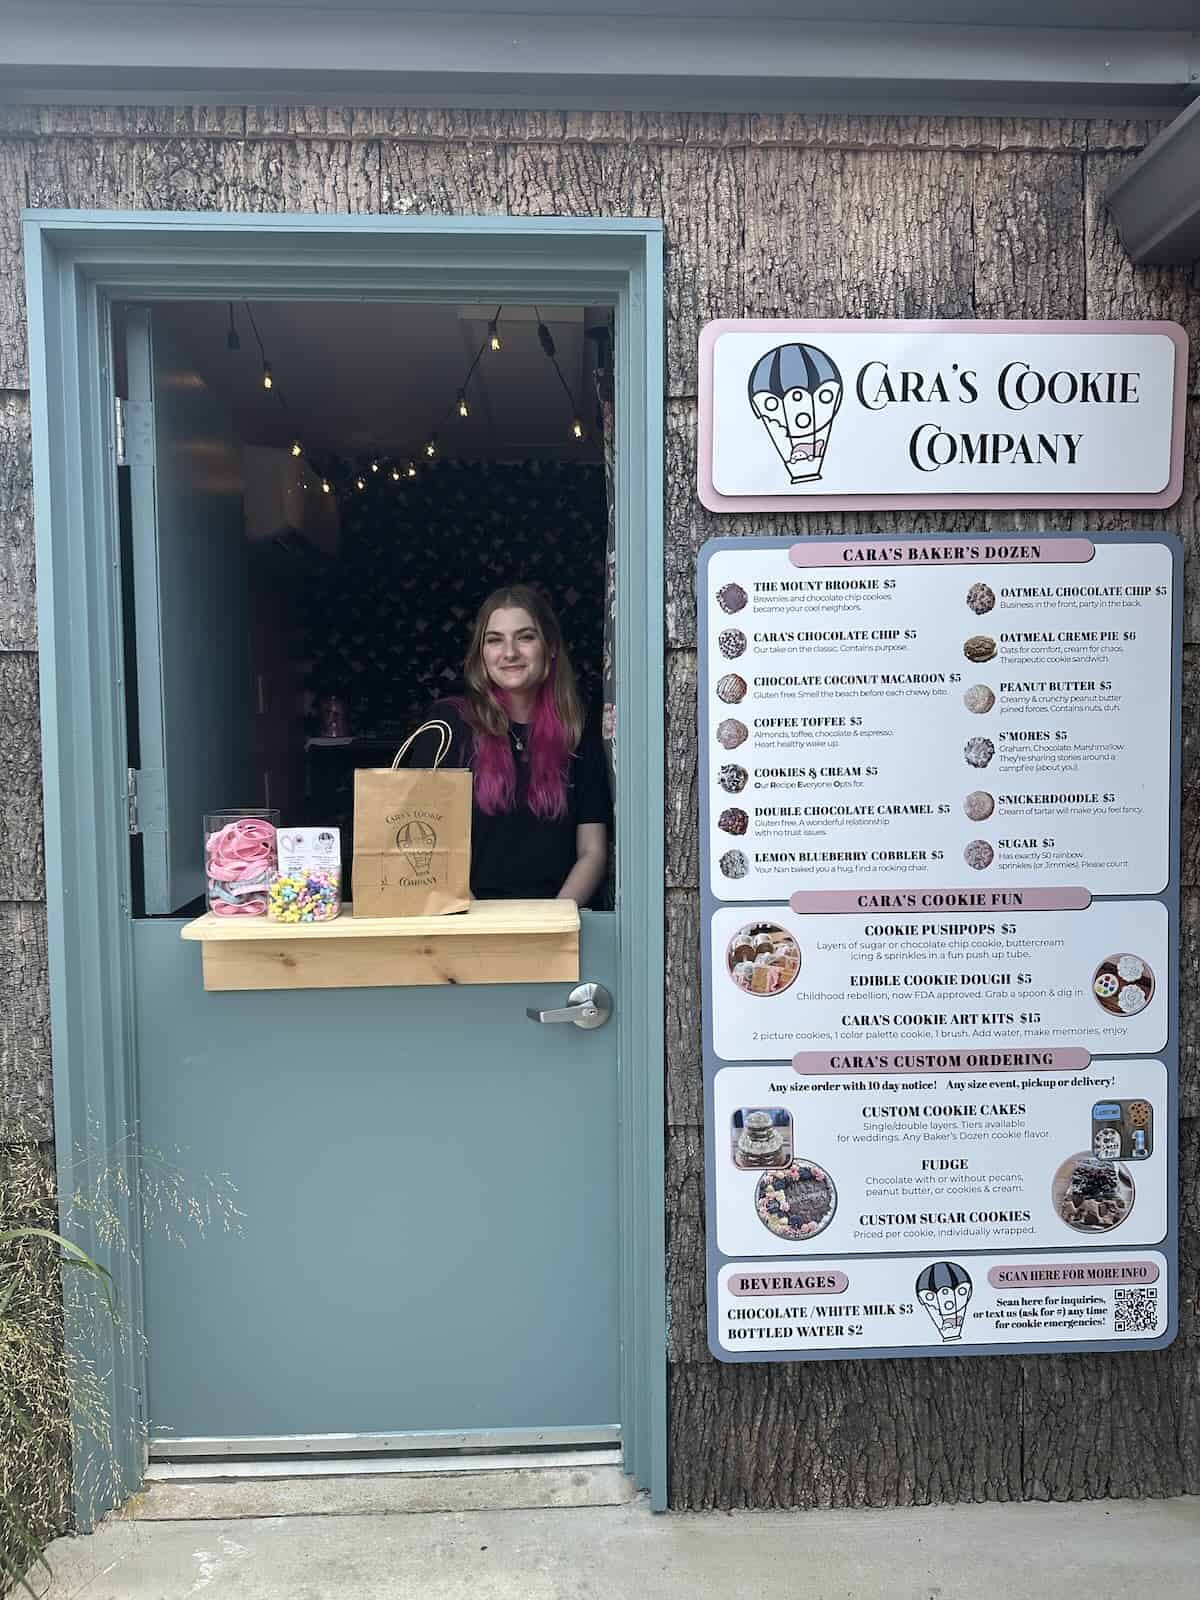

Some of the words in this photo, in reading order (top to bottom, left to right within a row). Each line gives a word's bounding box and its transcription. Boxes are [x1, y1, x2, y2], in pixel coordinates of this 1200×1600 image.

[997, 361, 1141, 410] COOKIE
[909, 423, 1084, 472] COMPANY
[842, 548, 903, 562] CARA'S
[908, 547, 980, 561] BAKER'S
[984, 546, 1041, 558] DOZEN
[753, 582, 778, 591] THE
[780, 581, 823, 591] MOUNT
[825, 580, 880, 590] BROOKIE
[883, 580, 896, 589] $5
[1000, 588, 1054, 597] OATMEAL
[1055, 587, 1123, 597] CHOCOLATE
[1124, 586, 1152, 596] CHIP
[1155, 586, 1167, 595] $5
[785, 606, 803, 614] your
[753, 632, 795, 642] CARA'S
[796, 631, 869, 641] CHOCOLATE
[871, 630, 900, 639] CHIP
[903, 630, 917, 639] $5
[1000, 632, 1056, 642] OATMEAL
[1057, 632, 1098, 641] CREME
[1100, 632, 1119, 640] PIE
[753, 676, 822, 686] CHOCOLATE
[823, 675, 879, 685] COCONUT
[880, 674, 945, 684] MACAROON
[999, 682, 1048, 692] PEANUT
[1049, 682, 1096, 691] BUTTER
[1099, 681, 1112, 690] $5
[753, 718, 799, 727] COFFEE
[800, 717, 846, 727] TOFFEE
[849, 717, 863, 726] $5
[998, 731, 1050, 741] S'MORES
[1055, 731, 1068, 740] $5
[754, 768, 806, 777] COOKIES
[808, 768, 817, 779] &
[820, 767, 861, 776] CREAM
[998, 794, 1099, 804] SNICKERDOODLE
[755, 807, 802, 816] DOUBLE
[803, 806, 875, 815] CHOCOLATE
[877, 805, 934, 814] CARAMEL
[998, 839, 1038, 848] SUGAR
[1042, 839, 1055, 848] $5
[755, 853, 796, 862] LEMON
[798, 852, 868, 861] BLUEBERRY
[871, 851, 927, 860] COBBLER
[857, 895, 919, 907] CARA'S
[919, 894, 987, 906] COOKIE
[991, 893, 1023, 905] FUN
[864, 925, 919, 936] COOKIE
[922, 924, 996, 935] PUSHPOPS
[1001, 924, 1017, 934] $5
[816, 940, 847, 952] Layers
[858, 942, 886, 951] sugar
[900, 939, 947, 949] chocolate
[948, 939, 968, 950] chip
[1006, 938, 1064, 947] buttercream
[850, 976, 901, 986] EDIBLE
[903, 975, 958, 985] COOKIE
[960, 974, 1011, 984] DOUGH
[1017, 974, 1032, 984] $5
[796, 991, 845, 1000] Childhood
[914, 990, 936, 999] FDA
[985, 989, 1009, 998] Grab
[1017, 990, 1047, 1000] spoon
[1056, 988, 1073, 999] dig
[841, 1015, 890, 1026] CARA'S
[893, 1014, 948, 1025] COOKIE
[950, 1014, 979, 1024] ART
[981, 1014, 1014, 1024] KITS
[1019, 1013, 1041, 1024] $15
[830, 1056, 889, 1068] CARA'S
[894, 1055, 961, 1068] CUSTOM
[966, 1053, 1053, 1066] ORDERING
[769, 1082, 788, 1095] Any
[789, 1082, 810, 1092] size
[811, 1081, 841, 1092] order
[842, 1081, 866, 1091] with
[868, 1080, 881, 1091] 10
[881, 1080, 899, 1093] day
[901, 1079, 937, 1090] notice!
[946, 1079, 966, 1091] Any
[967, 1078, 988, 1089] size
[988, 1078, 1020, 1090] event,
[1021, 1077, 1056, 1090] pickup
[1070, 1076, 1115, 1089] delivery!
[862, 1106, 920, 1117] CUSTOM
[923, 1105, 977, 1116] COOKIE
[980, 1104, 1026, 1115] CAKES
[921, 1159, 969, 1170] FUDGE
[865, 1176, 914, 1185] Chocolate
[914, 1175, 936, 1185] with
[949, 1175, 987, 1184] without
[859, 1214, 917, 1225] CUSTOM
[919, 1213, 966, 1224] SUGAR
[969, 1211, 1031, 1222] COOKIES
[853, 1230, 885, 1239] Priced
[885, 1232, 902, 1240] per
[937, 1227, 991, 1239] individually
[998, 1271, 1029, 1281] SCAN
[1030, 1269, 1061, 1281] HERE
[1062, 1268, 1085, 1280] FOR
[1086, 1267, 1120, 1279] MORE
[1121, 1267, 1148, 1279] INFO
[739, 1276, 837, 1291] BEVERAGES
[996, 1297, 1020, 1307] Scan
[1020, 1297, 1045, 1306] here
[1044, 1297, 1060, 1306] for
[727, 1307, 808, 1319] CHOCOLATE
[863, 1304, 896, 1315] MILK
[898, 1304, 914, 1314] $3
[985, 1310, 1005, 1319] text
[1018, 1309, 1039, 1319] (ask
[1040, 1308, 1055, 1319] for
[1067, 1310, 1084, 1319] any
[1086, 1307, 1108, 1317] time
[995, 1319, 1010, 1329] for
[1010, 1319, 1042, 1329] cookie
[1043, 1318, 1106, 1329] emergencies!
[728, 1328, 793, 1339] BOTTLED
[796, 1326, 844, 1336] WATER
[847, 1325, 863, 1335] $2
